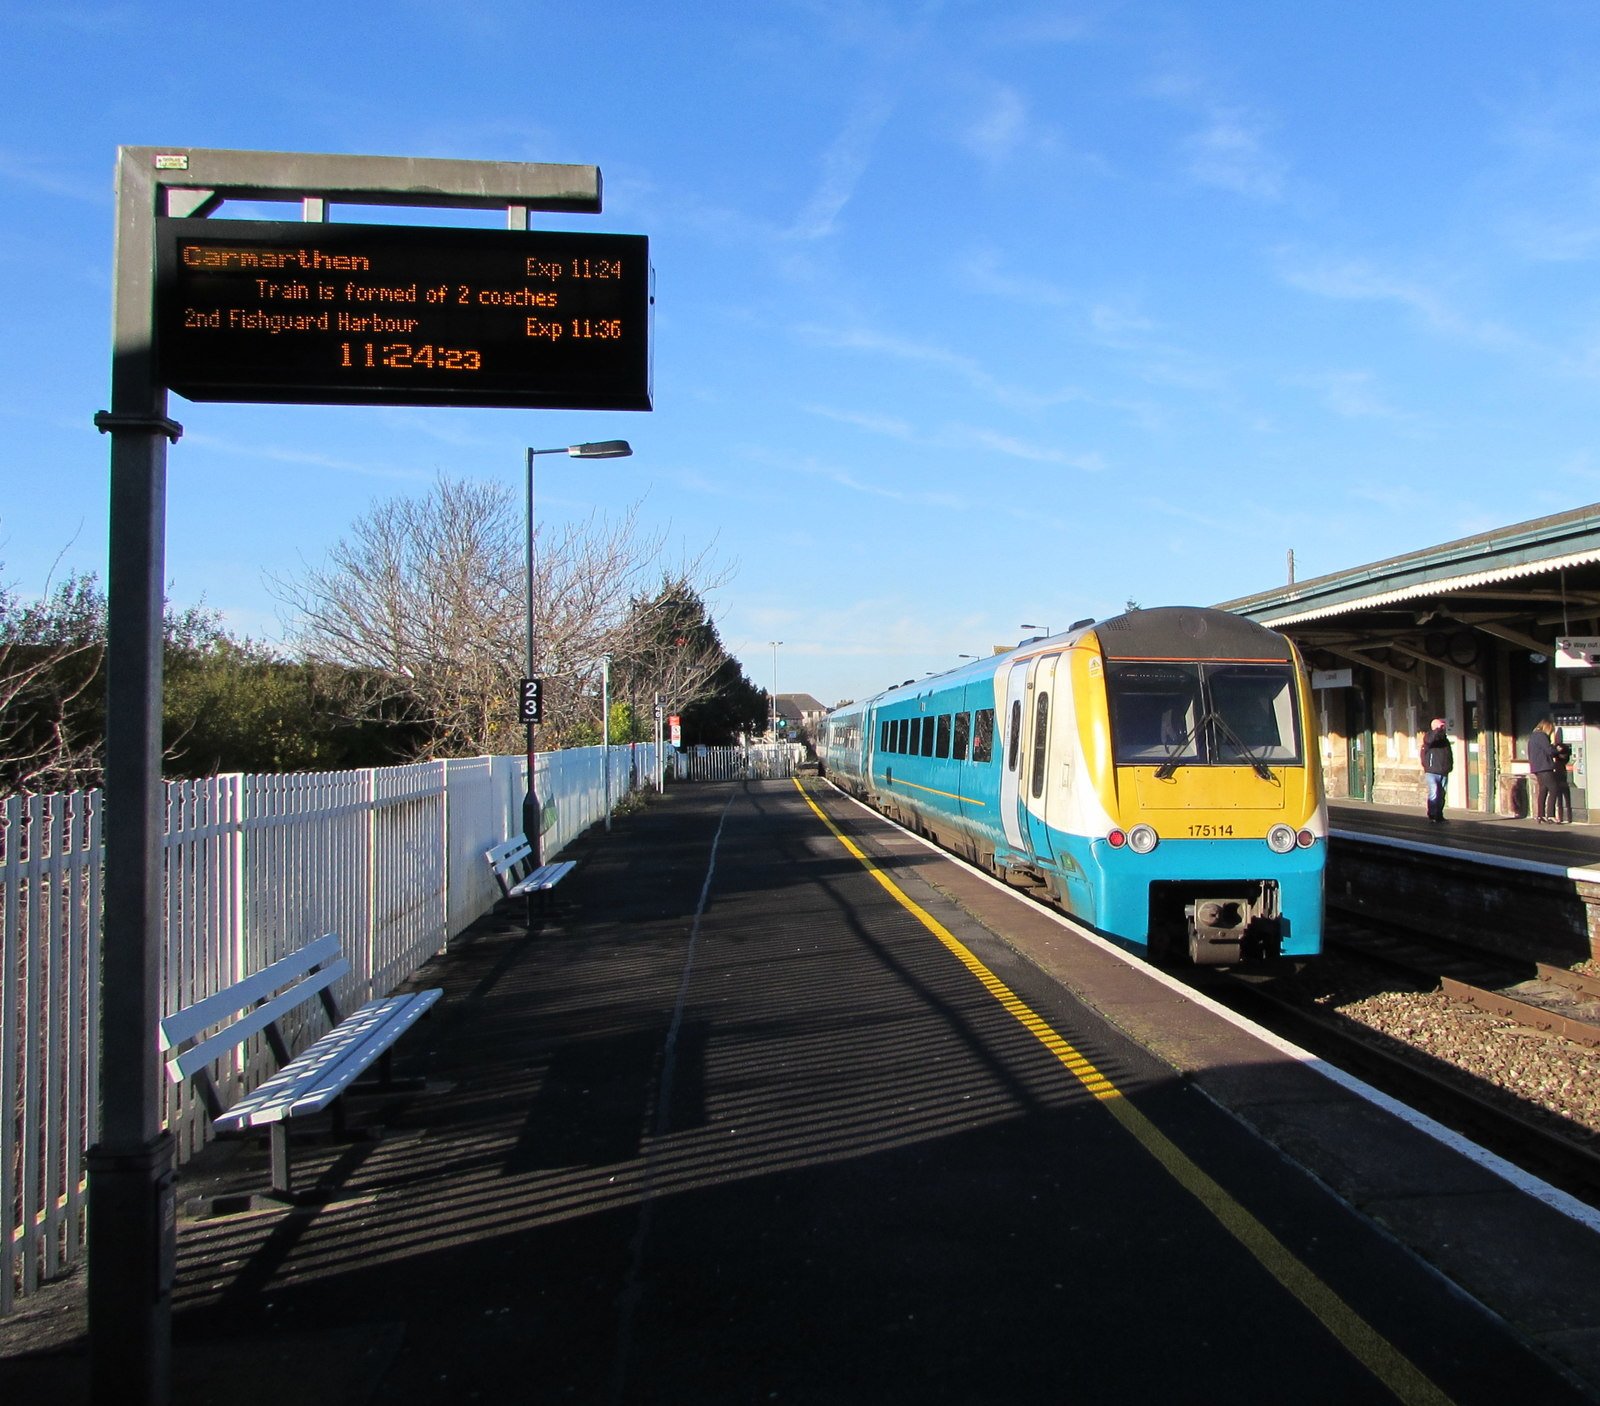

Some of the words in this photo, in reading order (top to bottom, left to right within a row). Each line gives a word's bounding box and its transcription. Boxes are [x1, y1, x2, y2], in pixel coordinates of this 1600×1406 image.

[183, 246, 371, 271] Carmarthen
[526, 257, 563, 281] Exp
[572, 258, 622, 279] 11:24
[255, 279, 310, 299] Train
[319, 281, 335, 300] is
[344, 282, 417, 302] formed
[426, 284, 448, 303] of
[459, 285, 470, 304] 2
[478, 287, 559, 307] coaches
[184, 308, 220, 328] 2nd
[229, 309, 329, 334] Fishguard
[338, 312, 419, 333] Harbour
[526, 317, 563, 341] Exp
[572, 318, 622, 339] 11:36
[341, 343, 482, 370] 11:24:23
[525, 681, 538, 697] 2
[525, 699, 538, 715] 3
[1187, 824, 1234, 837] 175114
